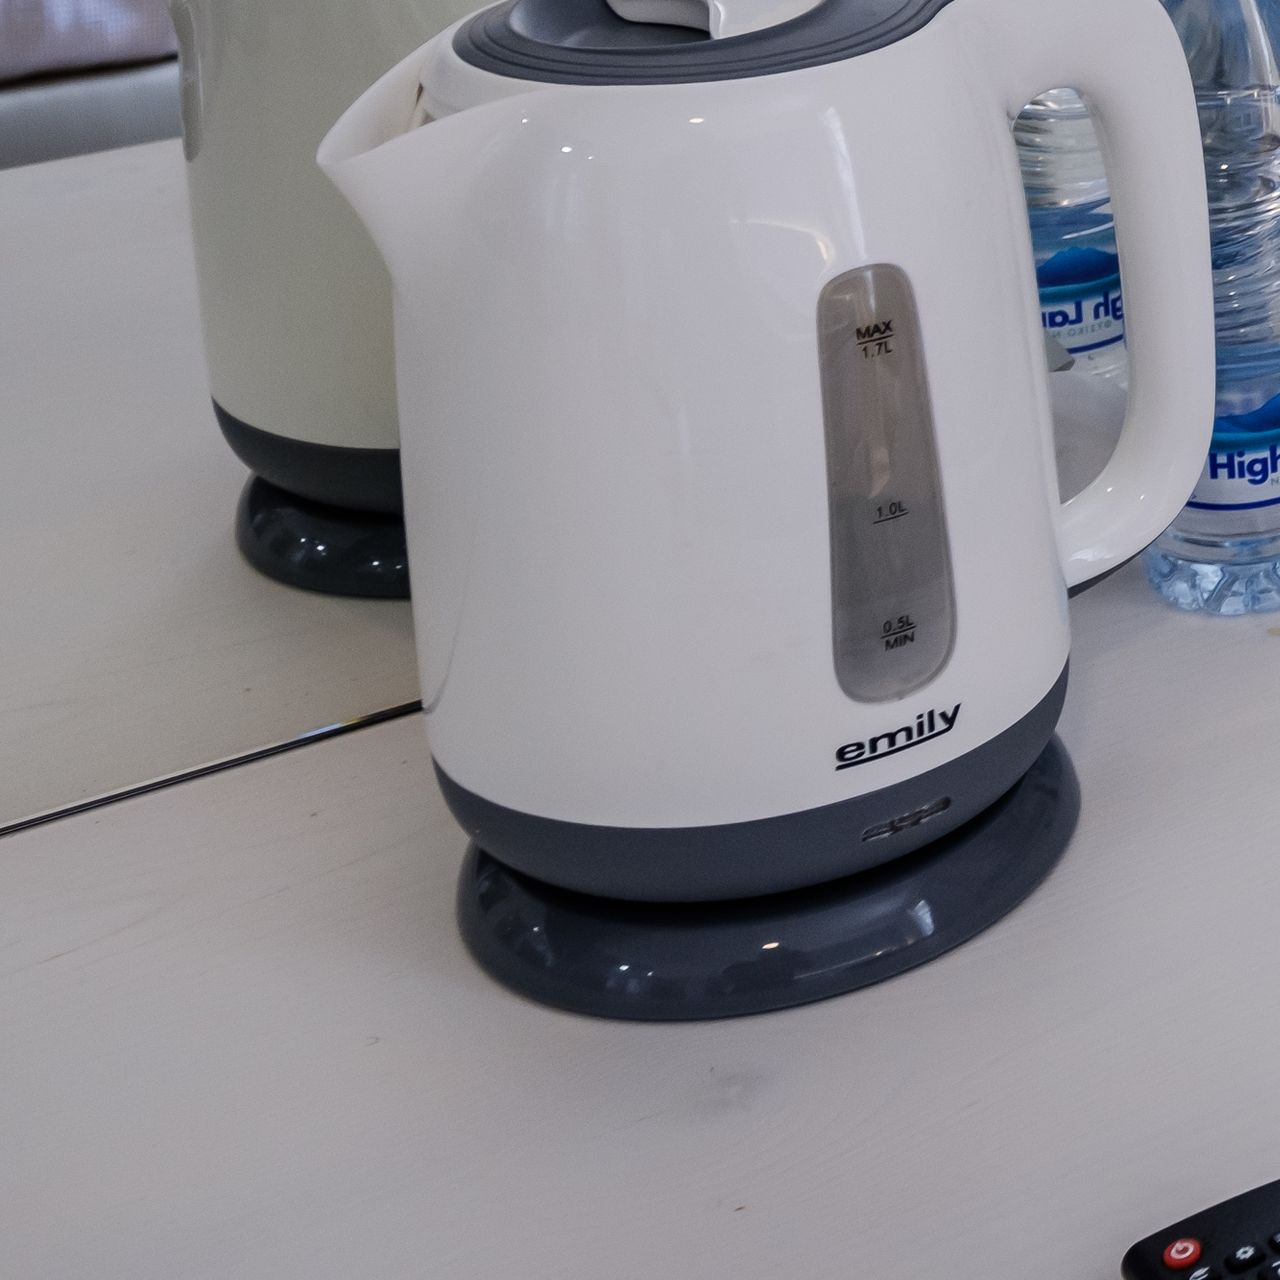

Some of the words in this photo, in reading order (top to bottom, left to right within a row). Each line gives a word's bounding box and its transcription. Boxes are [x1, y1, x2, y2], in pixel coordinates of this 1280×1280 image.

[855, 320, 893, 340] MAX
[862, 342, 893, 359] 1.7L
[877, 501, 907, 519] 1.0L
[883, 615, 914, 634] 0.5L
[885, 631, 914, 652] MIN
[835, 703, 961, 770] emily
